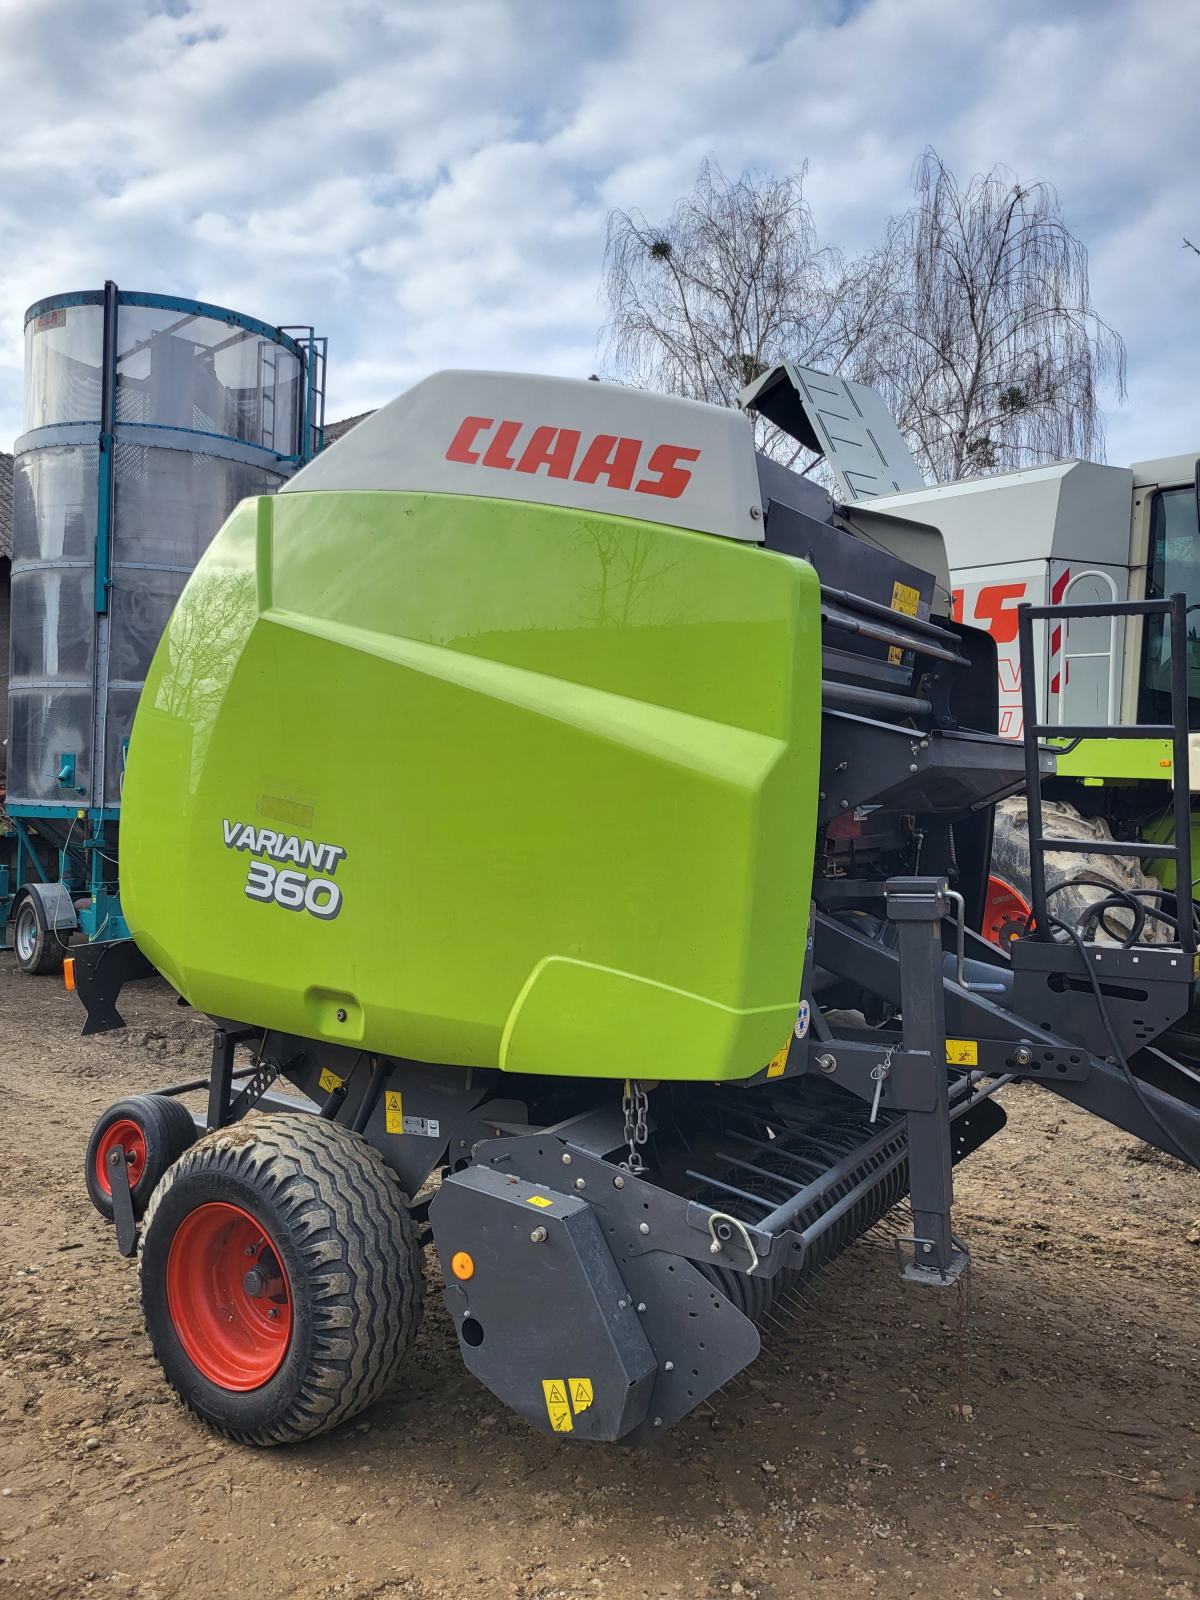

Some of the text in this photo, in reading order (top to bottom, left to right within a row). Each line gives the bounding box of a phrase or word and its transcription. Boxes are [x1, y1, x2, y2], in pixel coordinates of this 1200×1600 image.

[445, 416, 702, 499] CLAAS
[222, 818, 347, 876] VARIANT
[245, 860, 343, 921] 360
